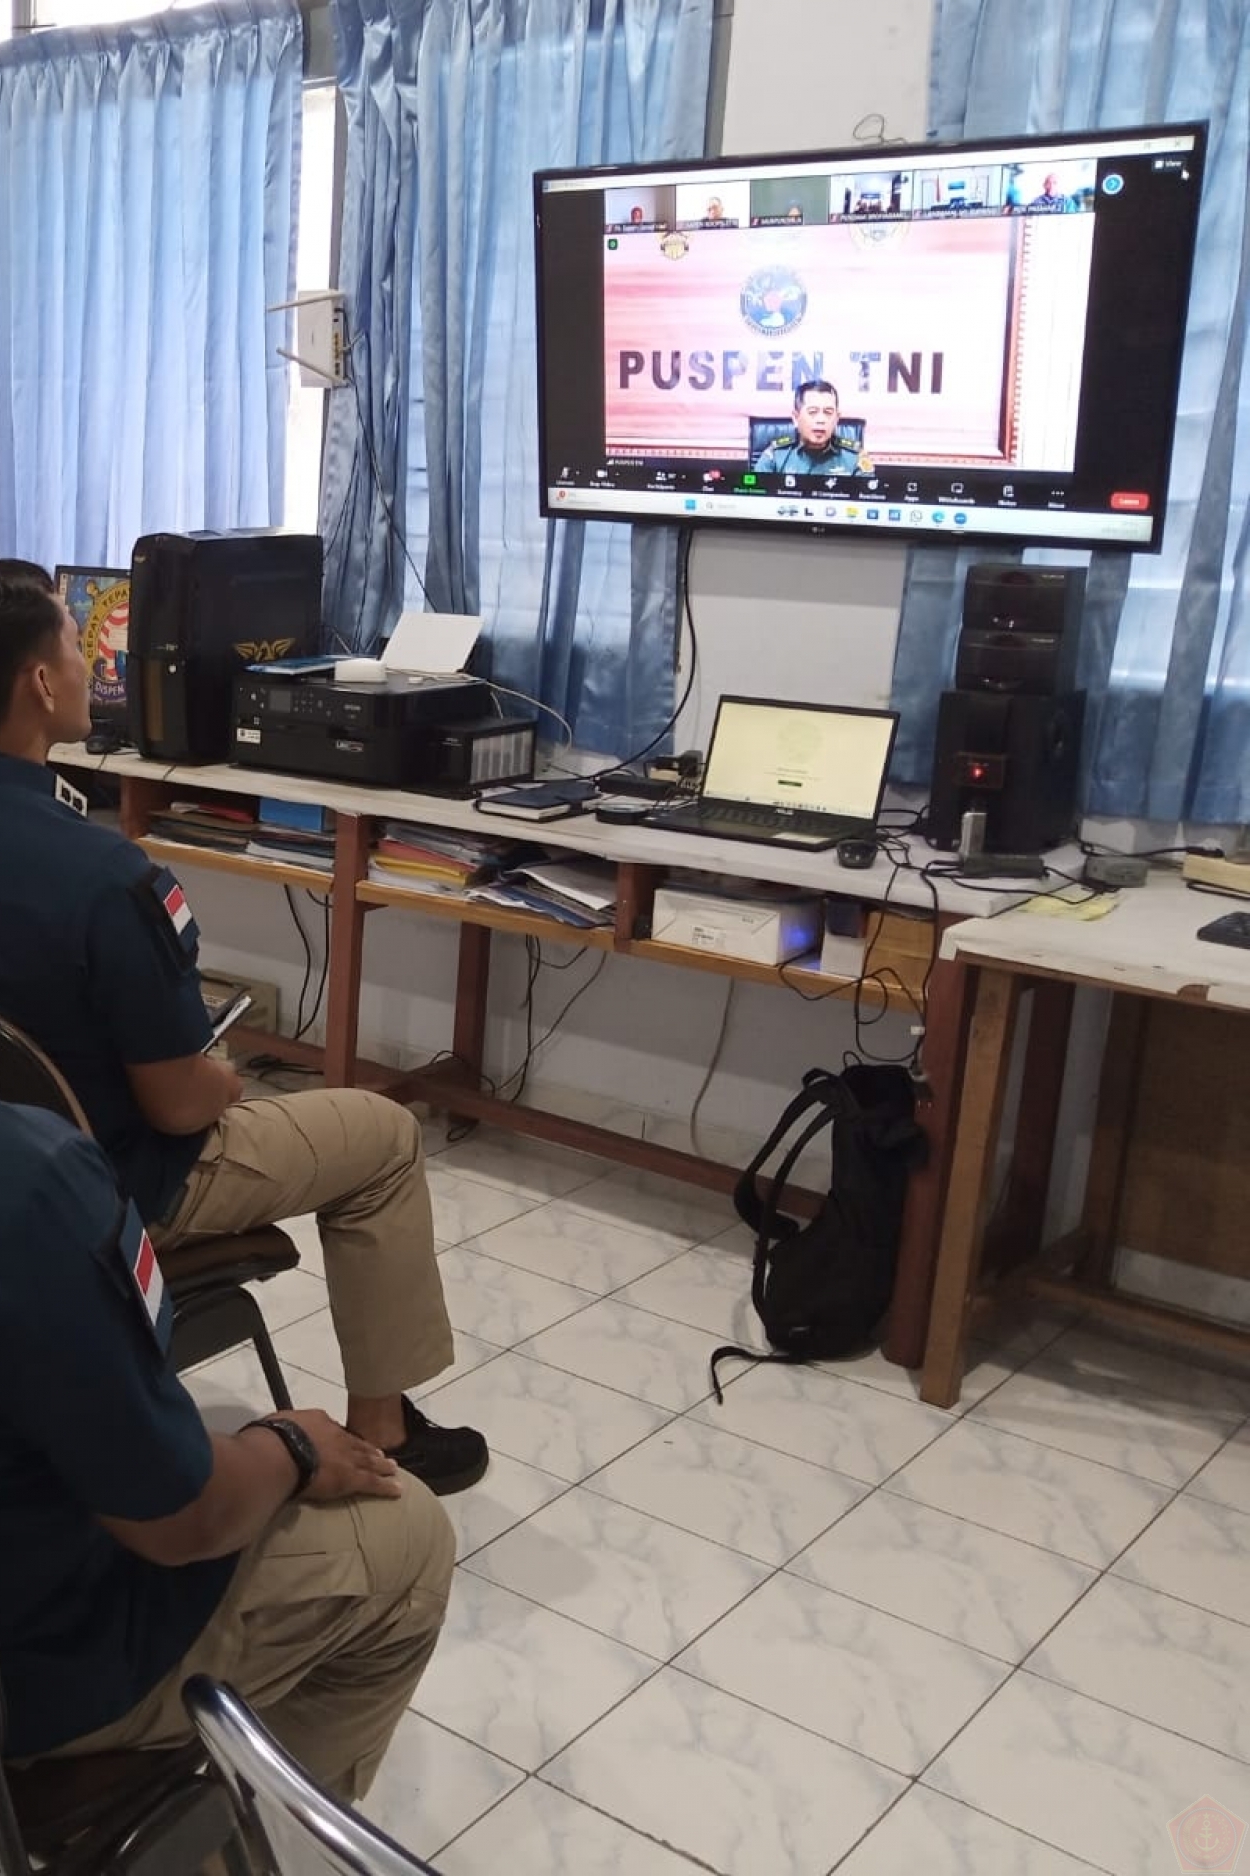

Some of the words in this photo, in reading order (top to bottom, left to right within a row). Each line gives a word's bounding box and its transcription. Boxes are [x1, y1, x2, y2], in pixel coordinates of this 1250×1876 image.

[619, 350, 824, 391] PUSPEN
[850, 351, 944, 394] TNI
[94, 681, 126, 697] DISPEN
